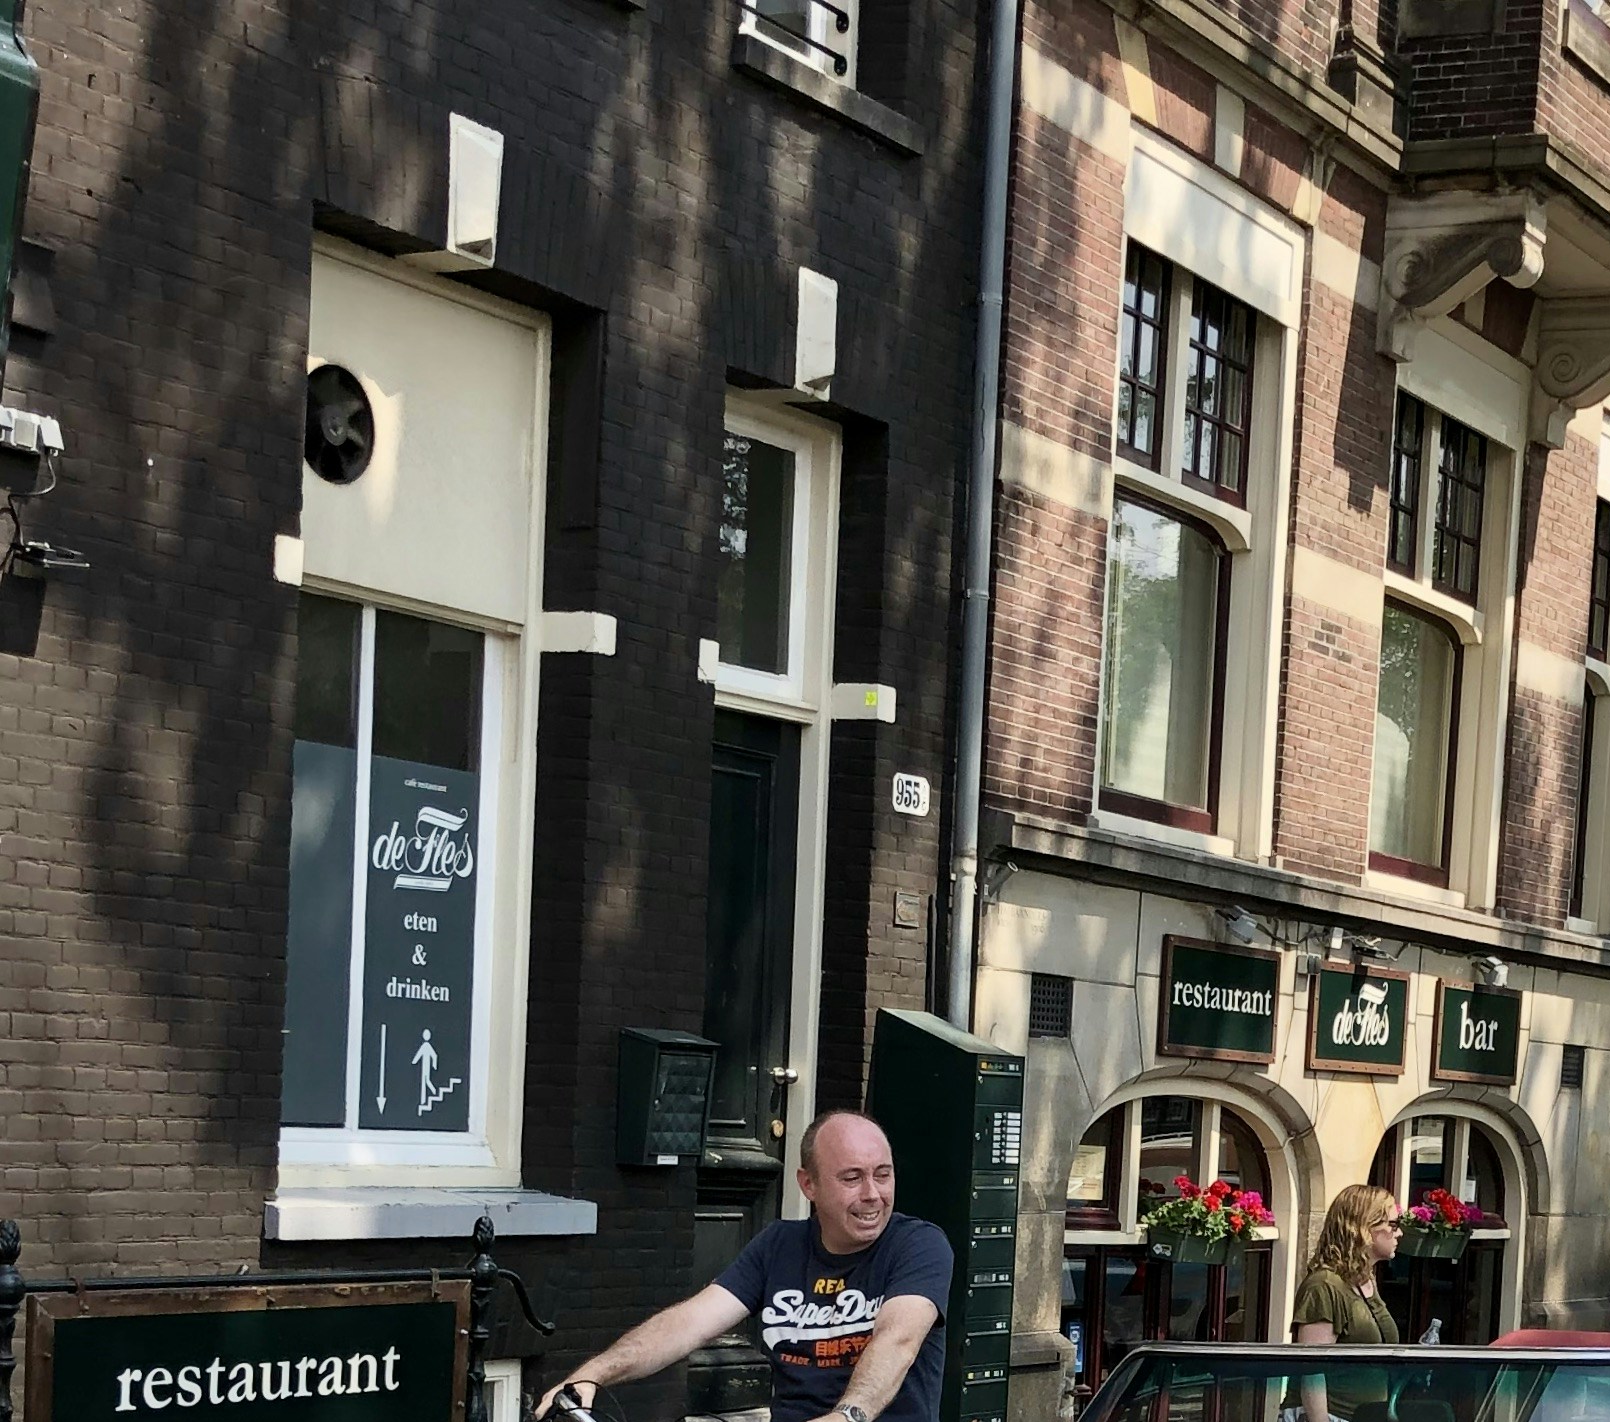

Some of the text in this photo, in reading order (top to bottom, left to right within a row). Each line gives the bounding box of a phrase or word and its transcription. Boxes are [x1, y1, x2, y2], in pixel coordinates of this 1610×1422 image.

[896, 778, 920, 809] 955
[403, 911, 438, 933] eten
[411, 943, 427, 966] &
[386, 976, 450, 1002] drinken
[1172, 980, 1272, 1017] restaurant
[1459, 1000, 1498, 1051] bar
[115, 1345, 401, 1412] restaurant
